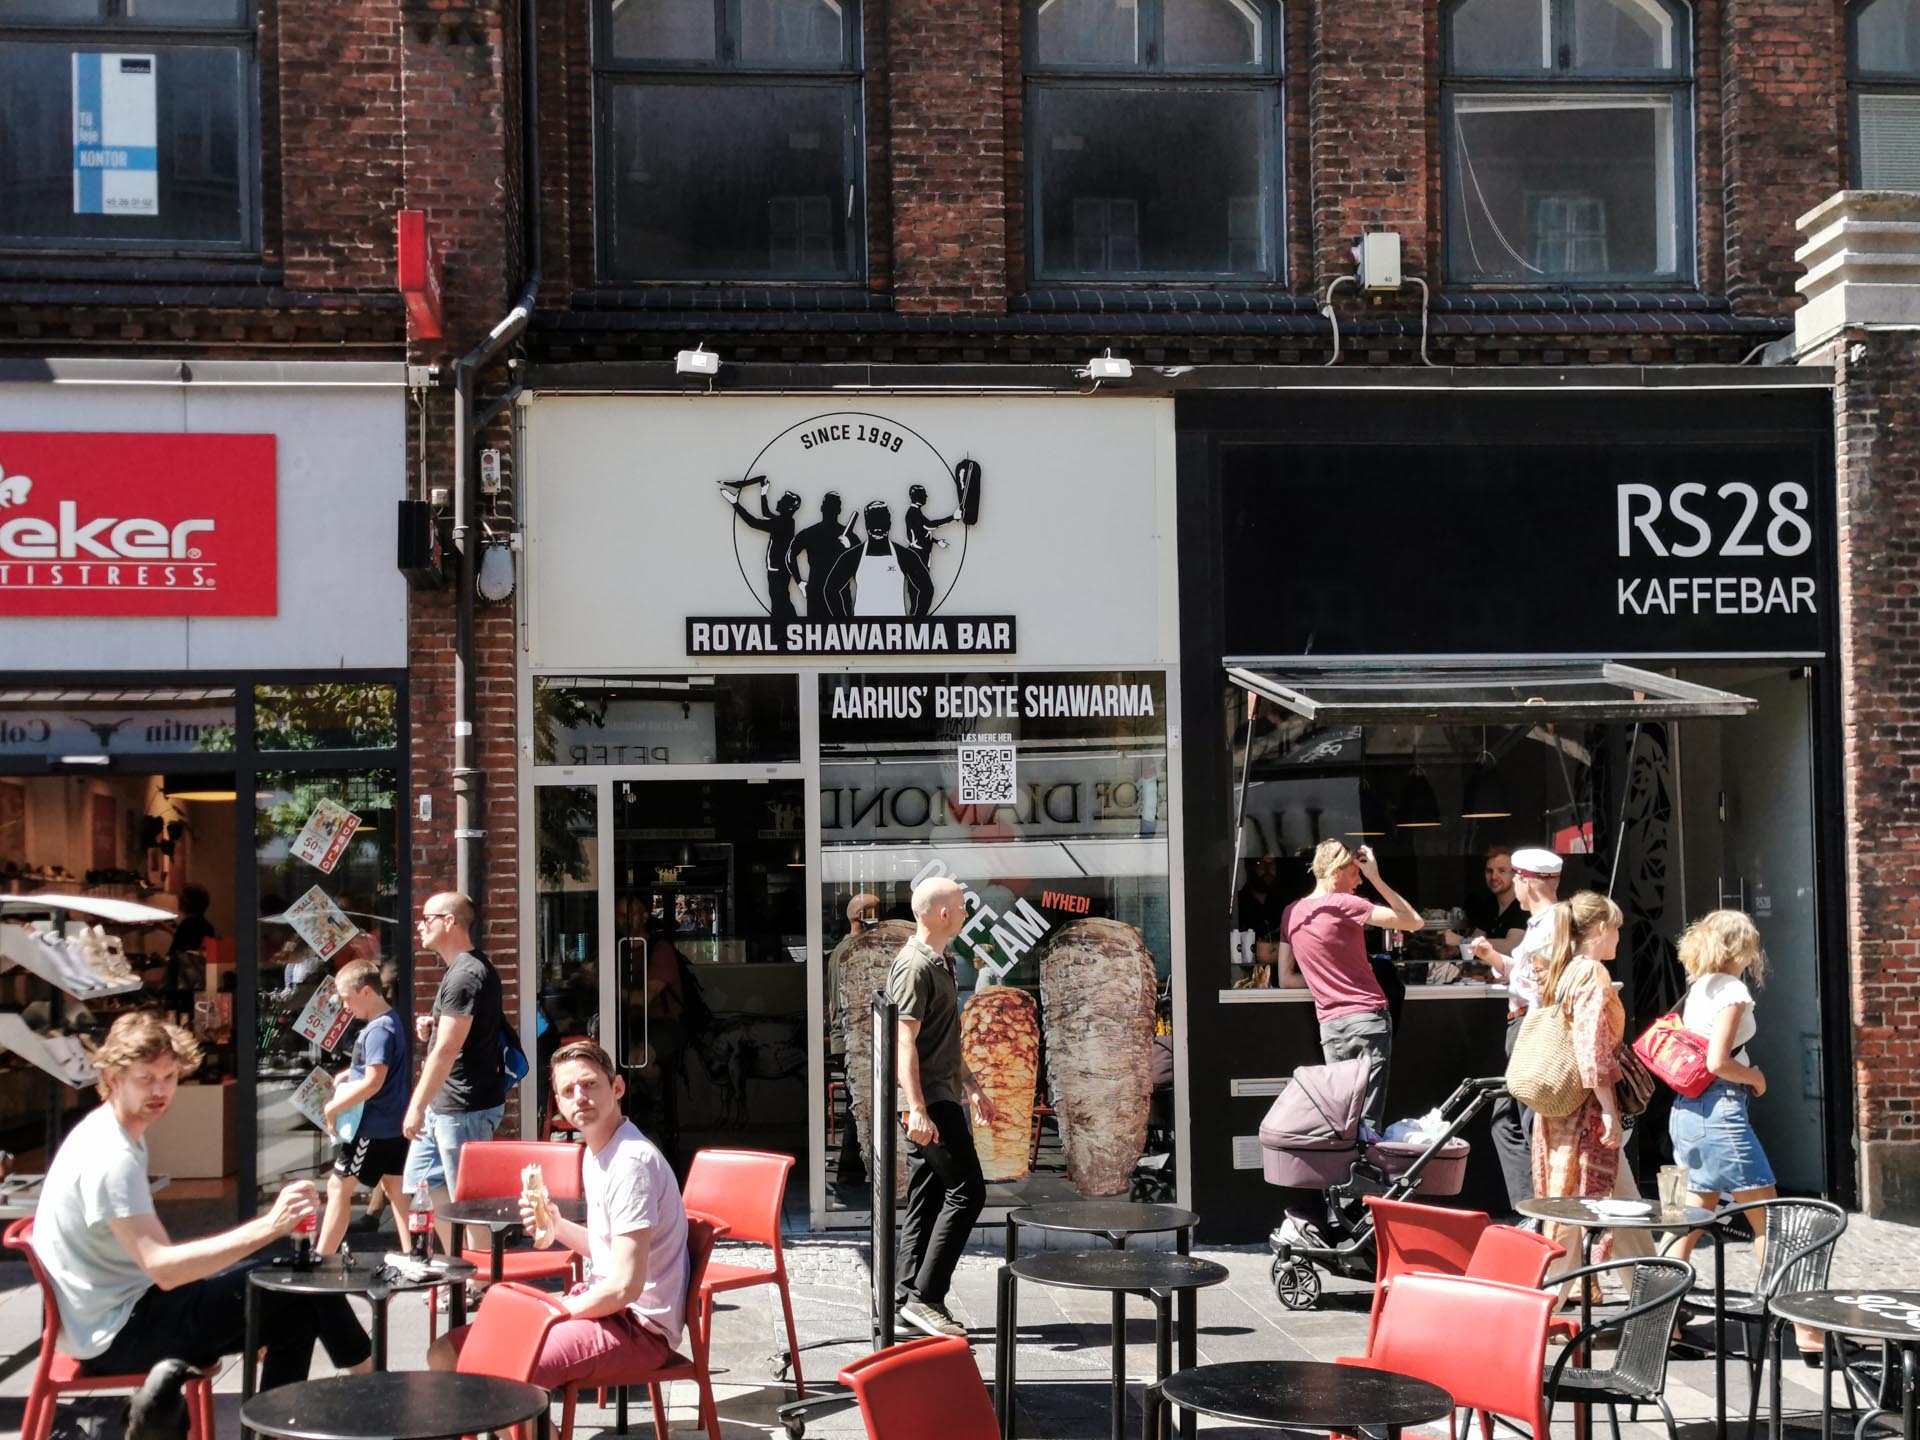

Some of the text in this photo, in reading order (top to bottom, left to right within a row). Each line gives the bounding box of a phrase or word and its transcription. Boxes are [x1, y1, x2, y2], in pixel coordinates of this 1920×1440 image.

[80, 151, 128, 168] KONTOR
[800, 424, 904, 453] SINCE 1999
[1617, 481, 1812, 558] RS28
[1617, 576, 1817, 615] KAFFEBAR
[692, 622, 1011, 651] ROYAL SHAWARMA BAR
[935, 686, 1019, 718] BEDSTE
[1024, 684, 1155, 718] SHAWARMA
[978, 732, 997, 743] MERE
[998, 732, 1013, 743] HER
[1041, 890, 1091, 914] NYHED!
[972, 897, 1052, 978] LAM
[306, 1013, 327, 1032] 50%
